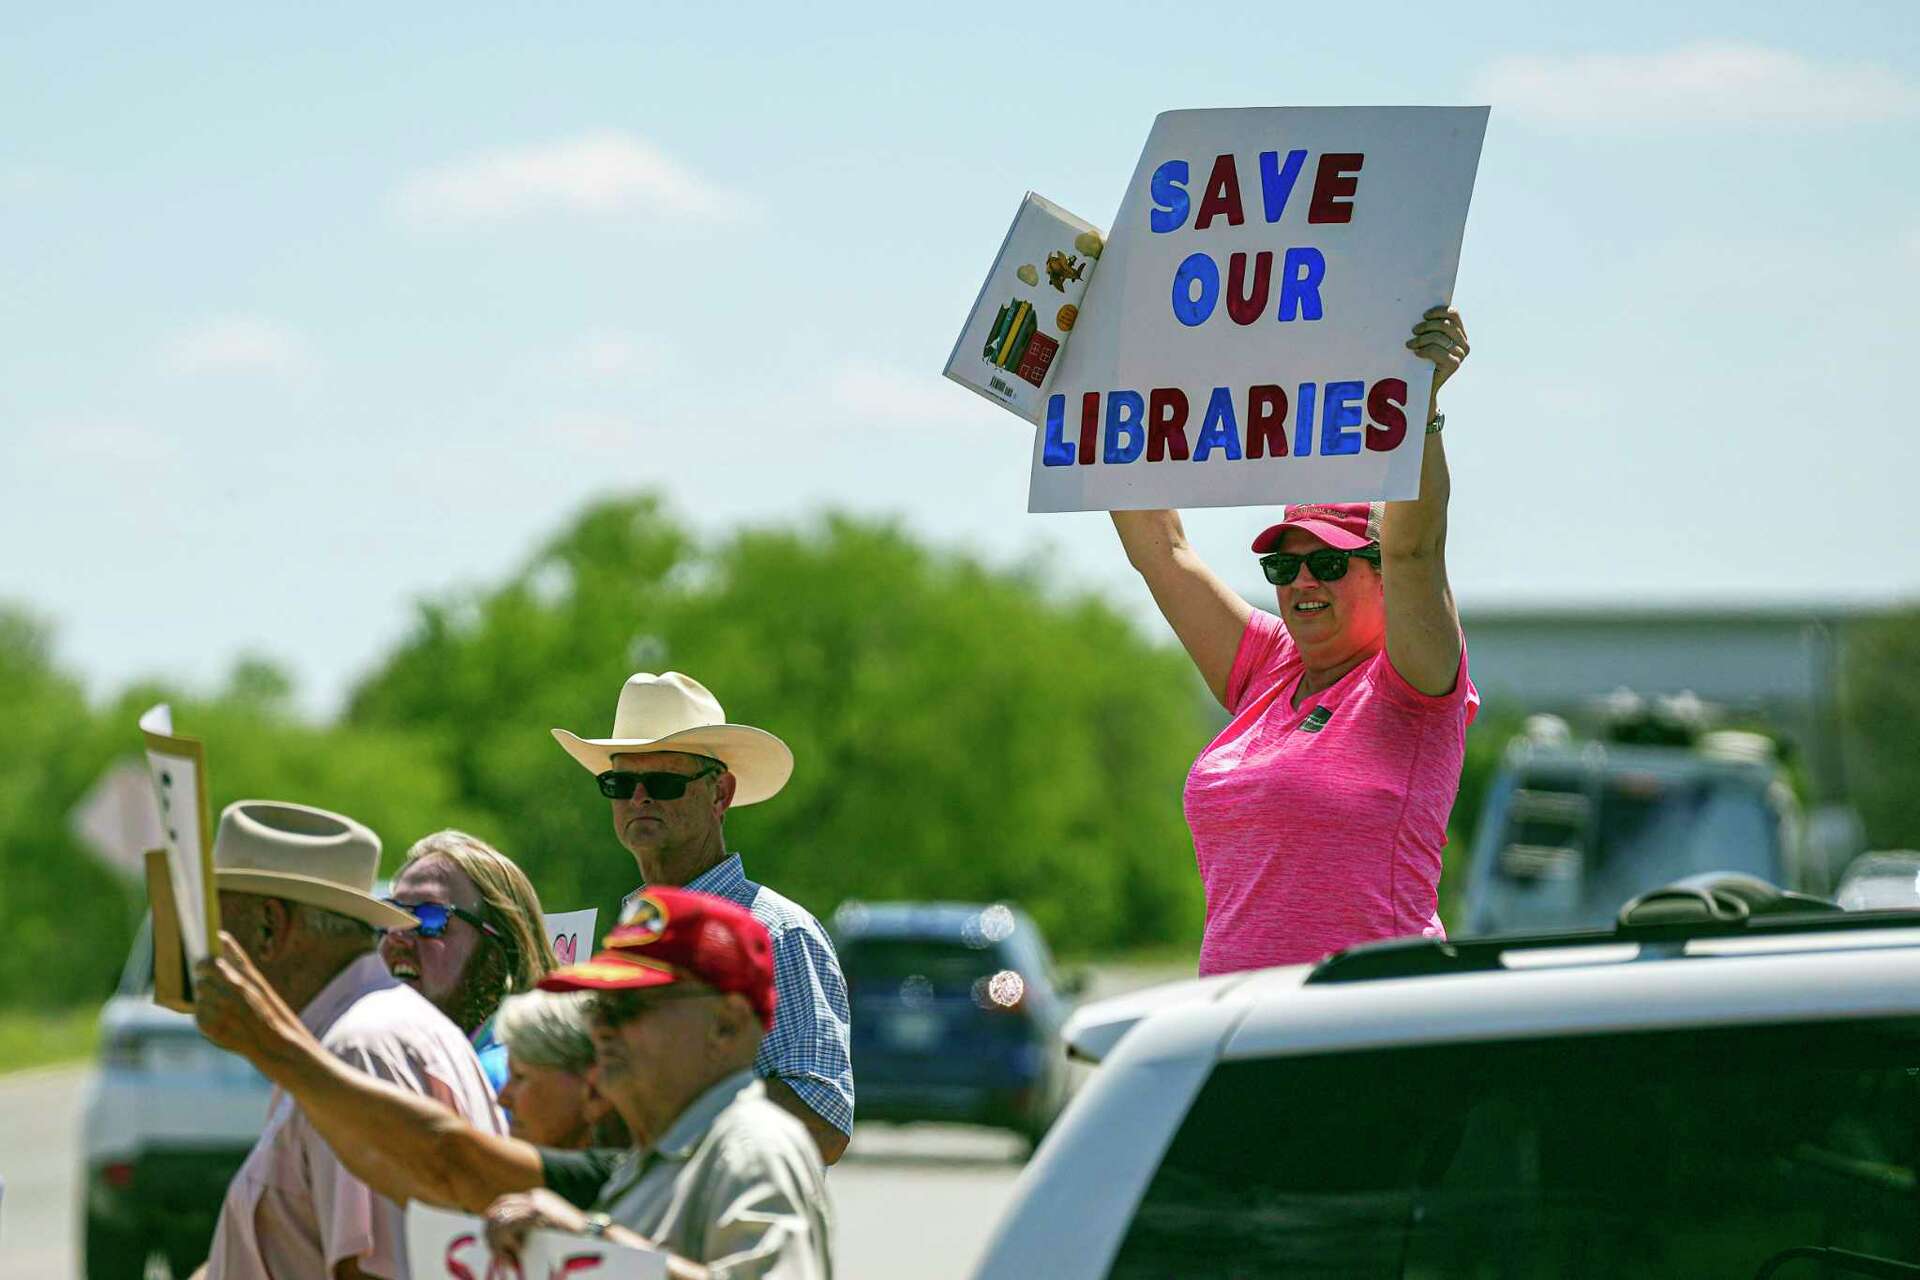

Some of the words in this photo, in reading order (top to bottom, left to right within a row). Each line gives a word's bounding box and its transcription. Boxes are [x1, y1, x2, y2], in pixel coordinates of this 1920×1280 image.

[1151, 149, 1364, 233] SAVE
[1172, 247, 1326, 327] OUR
[1043, 377, 1408, 467] LIBRARIES
